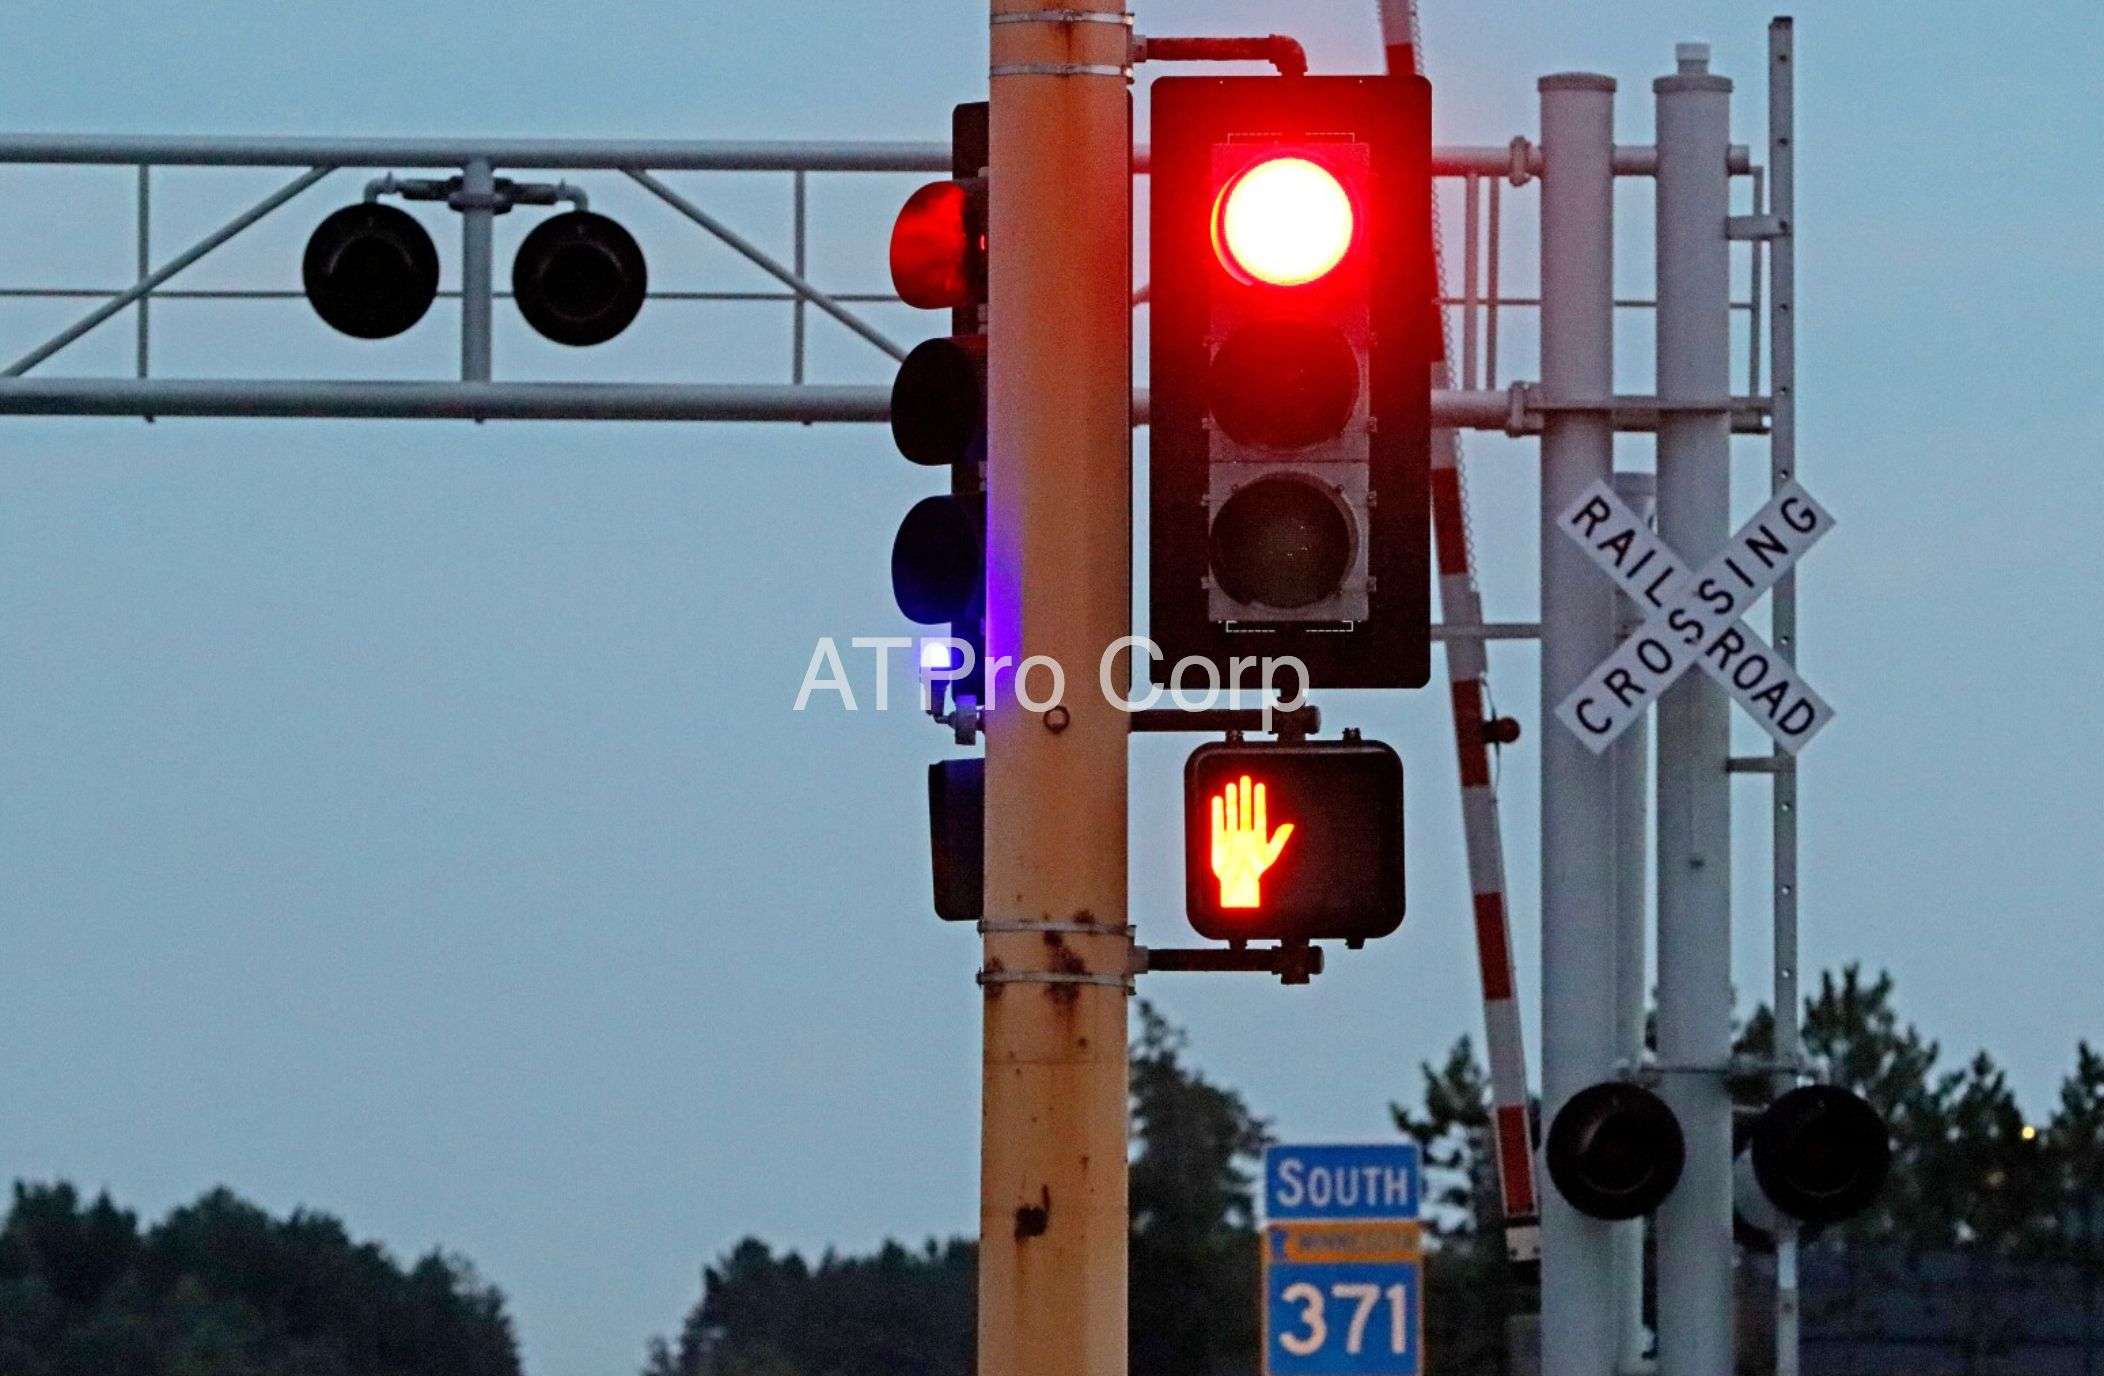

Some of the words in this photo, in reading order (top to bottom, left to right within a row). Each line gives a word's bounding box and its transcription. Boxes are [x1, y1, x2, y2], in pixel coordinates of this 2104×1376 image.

[1575, 497, 1817, 734] CROSSING
[1277, 1157, 1409, 1207] SOUTH
[1278, 1282, 1407, 1356] 371
